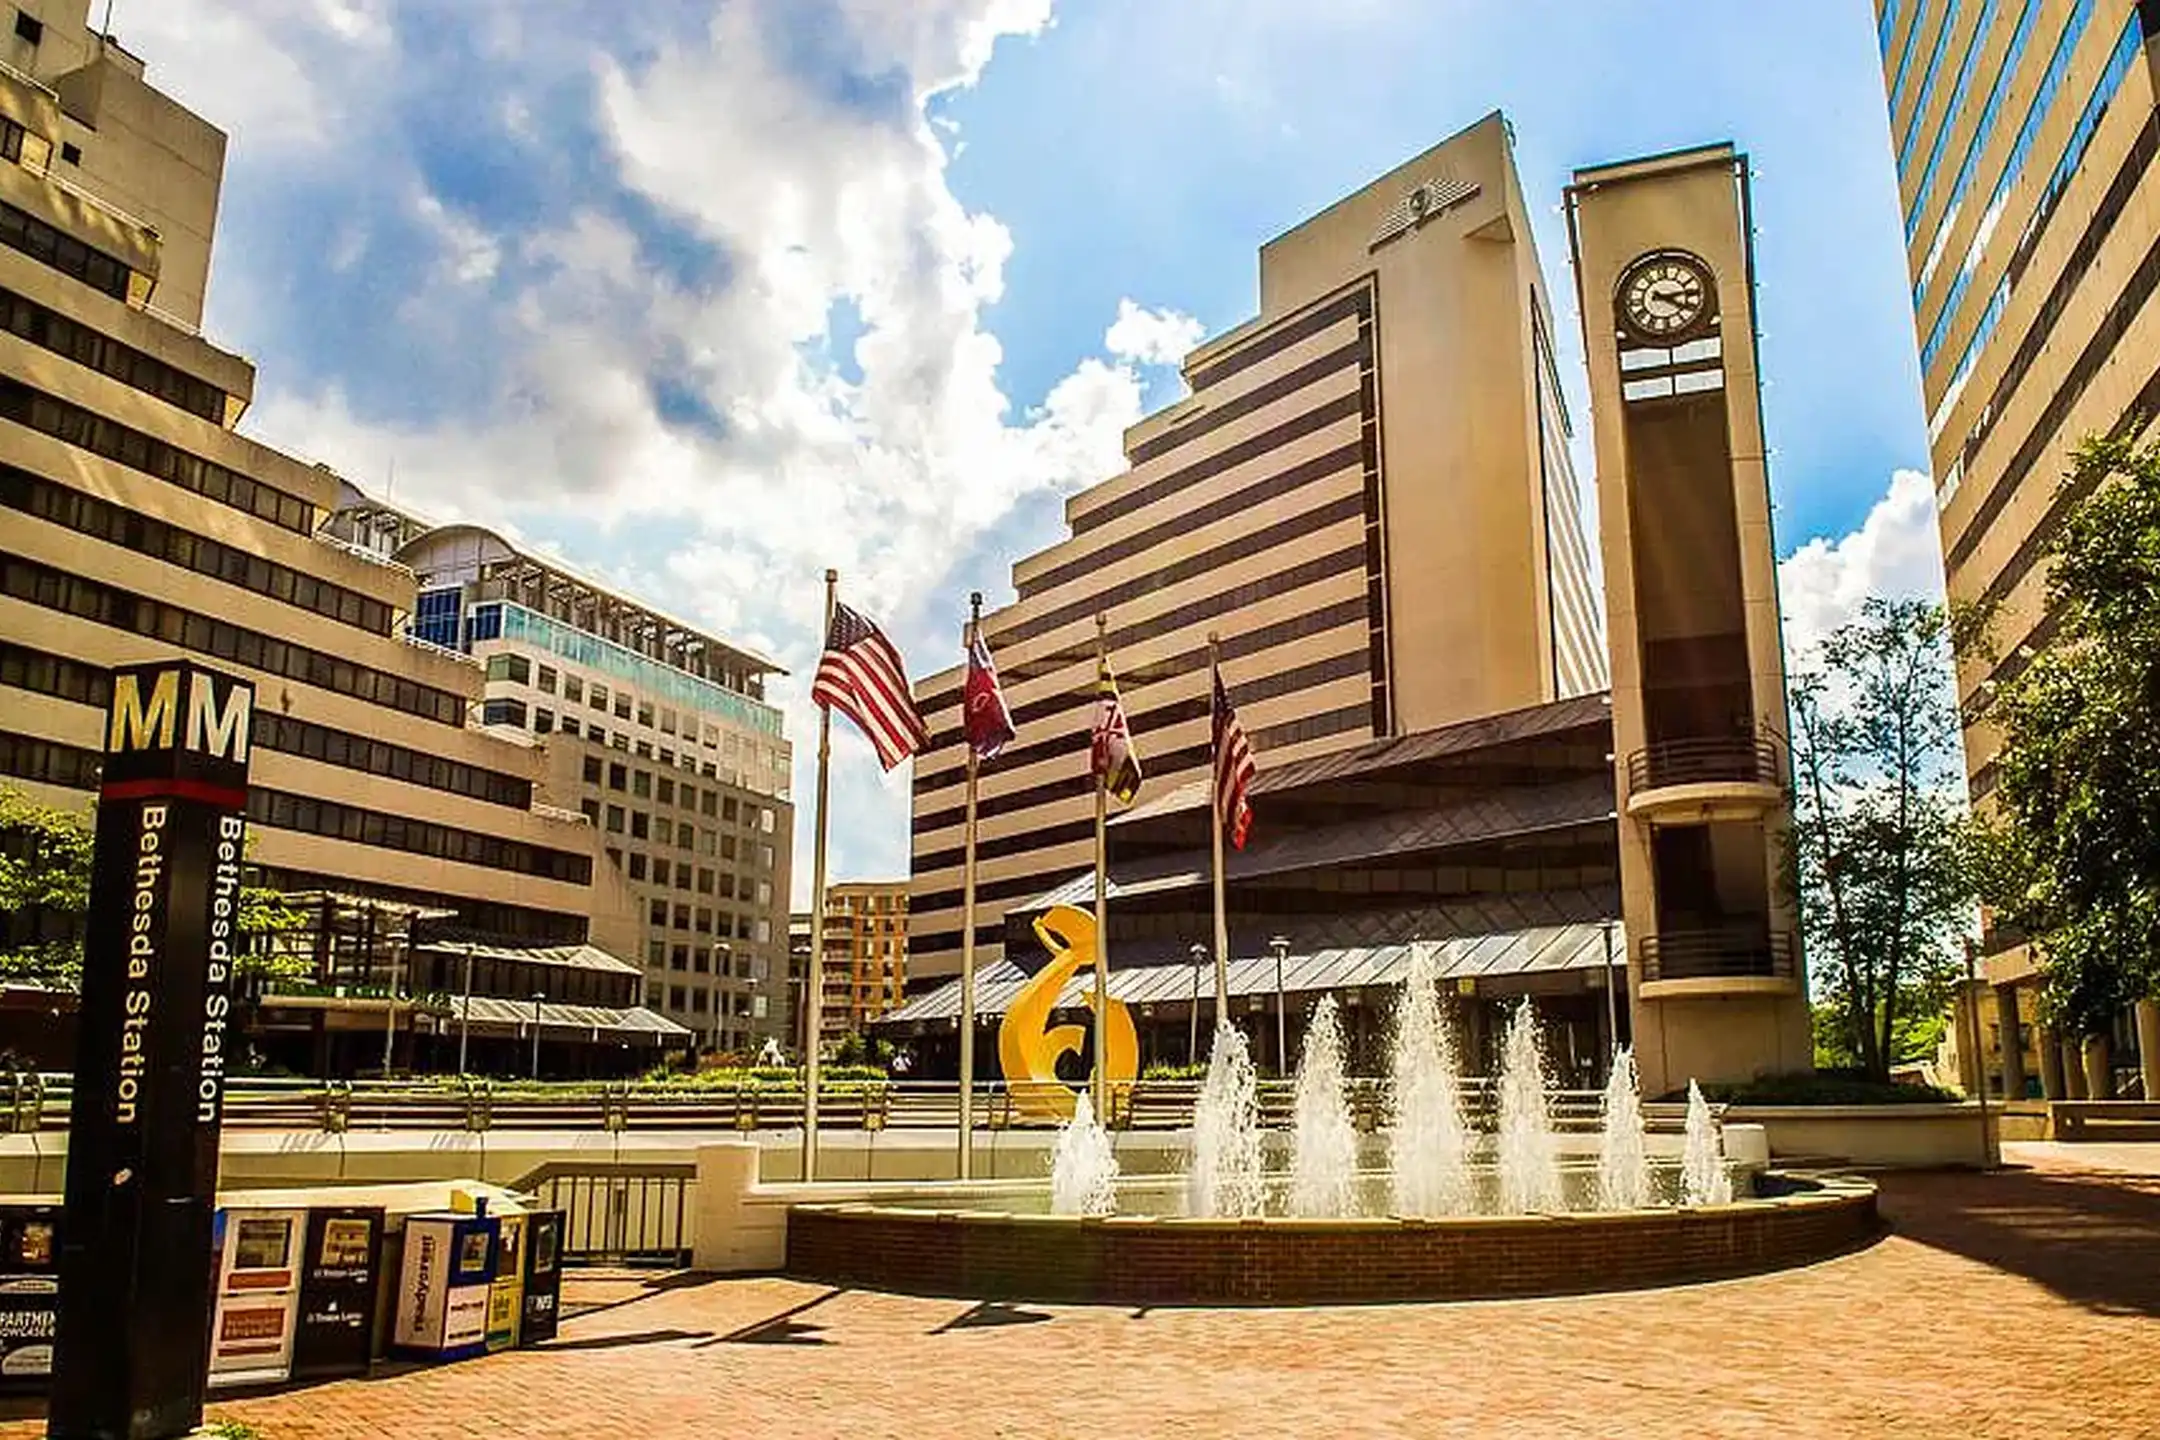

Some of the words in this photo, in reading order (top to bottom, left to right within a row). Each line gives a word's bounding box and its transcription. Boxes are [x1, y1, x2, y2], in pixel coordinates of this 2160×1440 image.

[110, 670, 181, 753] M
[185, 670, 251, 764] M
[127, 805, 168, 979] Bethesda
[208, 815, 243, 983] Bethesda
[116, 990, 151, 1124] Station
[197, 994, 230, 1123] Station
